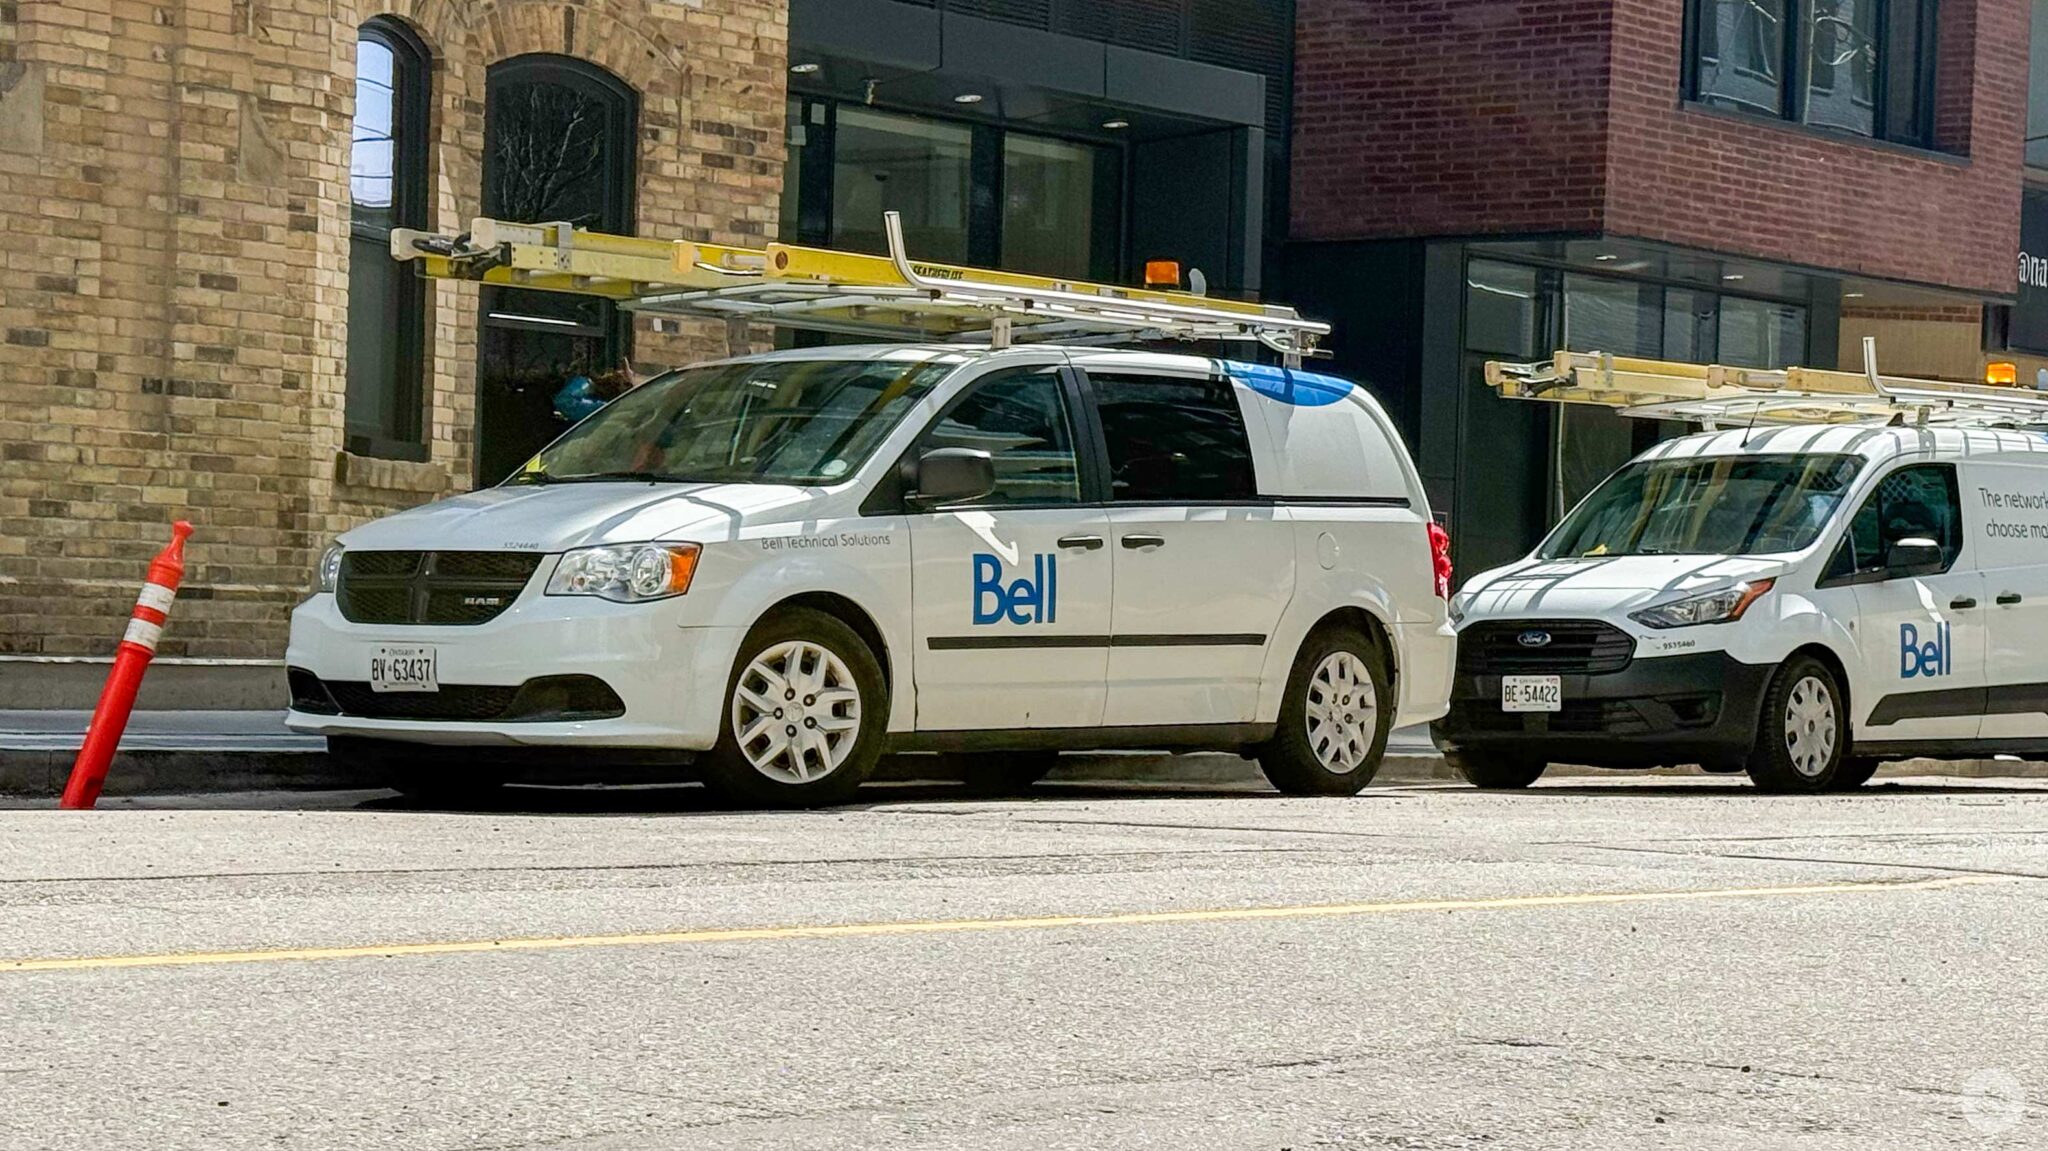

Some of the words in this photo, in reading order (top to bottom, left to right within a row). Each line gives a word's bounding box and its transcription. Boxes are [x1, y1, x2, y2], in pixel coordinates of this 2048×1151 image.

[1978, 487, 2003, 508] The
[1986, 518, 2028, 538] choose
[761, 536, 783, 550] Bell
[786, 534, 838, 549] Technical
[840, 533, 891, 547] Solutions
[972, 553, 1057, 625] Bell
[1900, 620, 1951, 679] Bell
[372, 658, 386, 681] BV
[393, 658, 431, 681] 63437
[1504, 685, 1518, 703] BE
[1524, 685, 1558, 703] 54422
